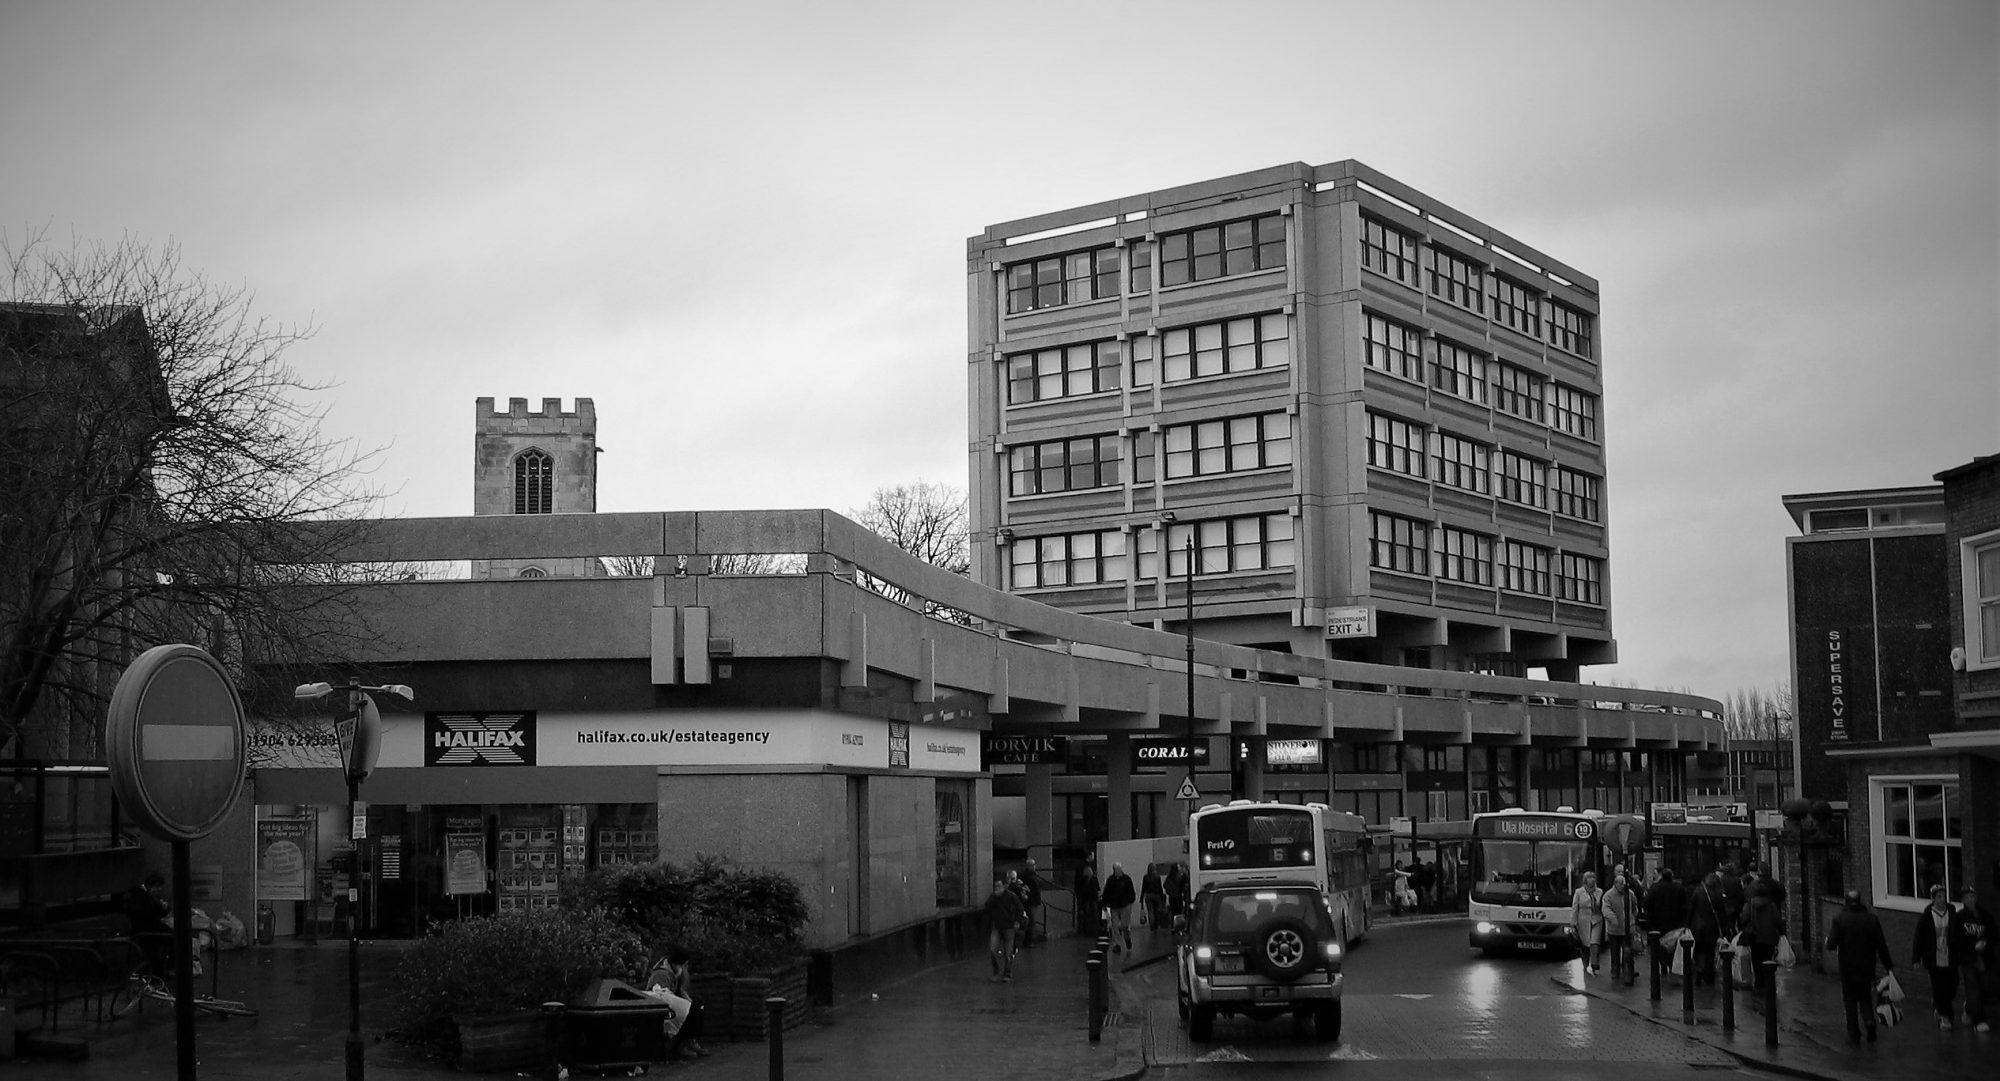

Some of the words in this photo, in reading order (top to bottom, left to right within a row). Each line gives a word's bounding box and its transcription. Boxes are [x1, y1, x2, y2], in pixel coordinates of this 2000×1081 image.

[1328, 624, 1352, 635] EXIT
[1829, 630, 1844, 728] SUPERSAVE
[434, 730, 526, 747] HALIFAX
[577, 729, 770, 744] halifax.co.uk/estateagency
[986, 738, 1056, 752] JORVIK
[1138, 746, 1189, 758] CORAL
[1501, 821, 1516, 834] Via
[1518, 821, 1558, 836] Hospital
[1563, 822, 1573, 836] 6
[1207, 840, 1224, 849] First
[1273, 848, 1284, 861] 6
[1518, 911, 1534, 919] First
